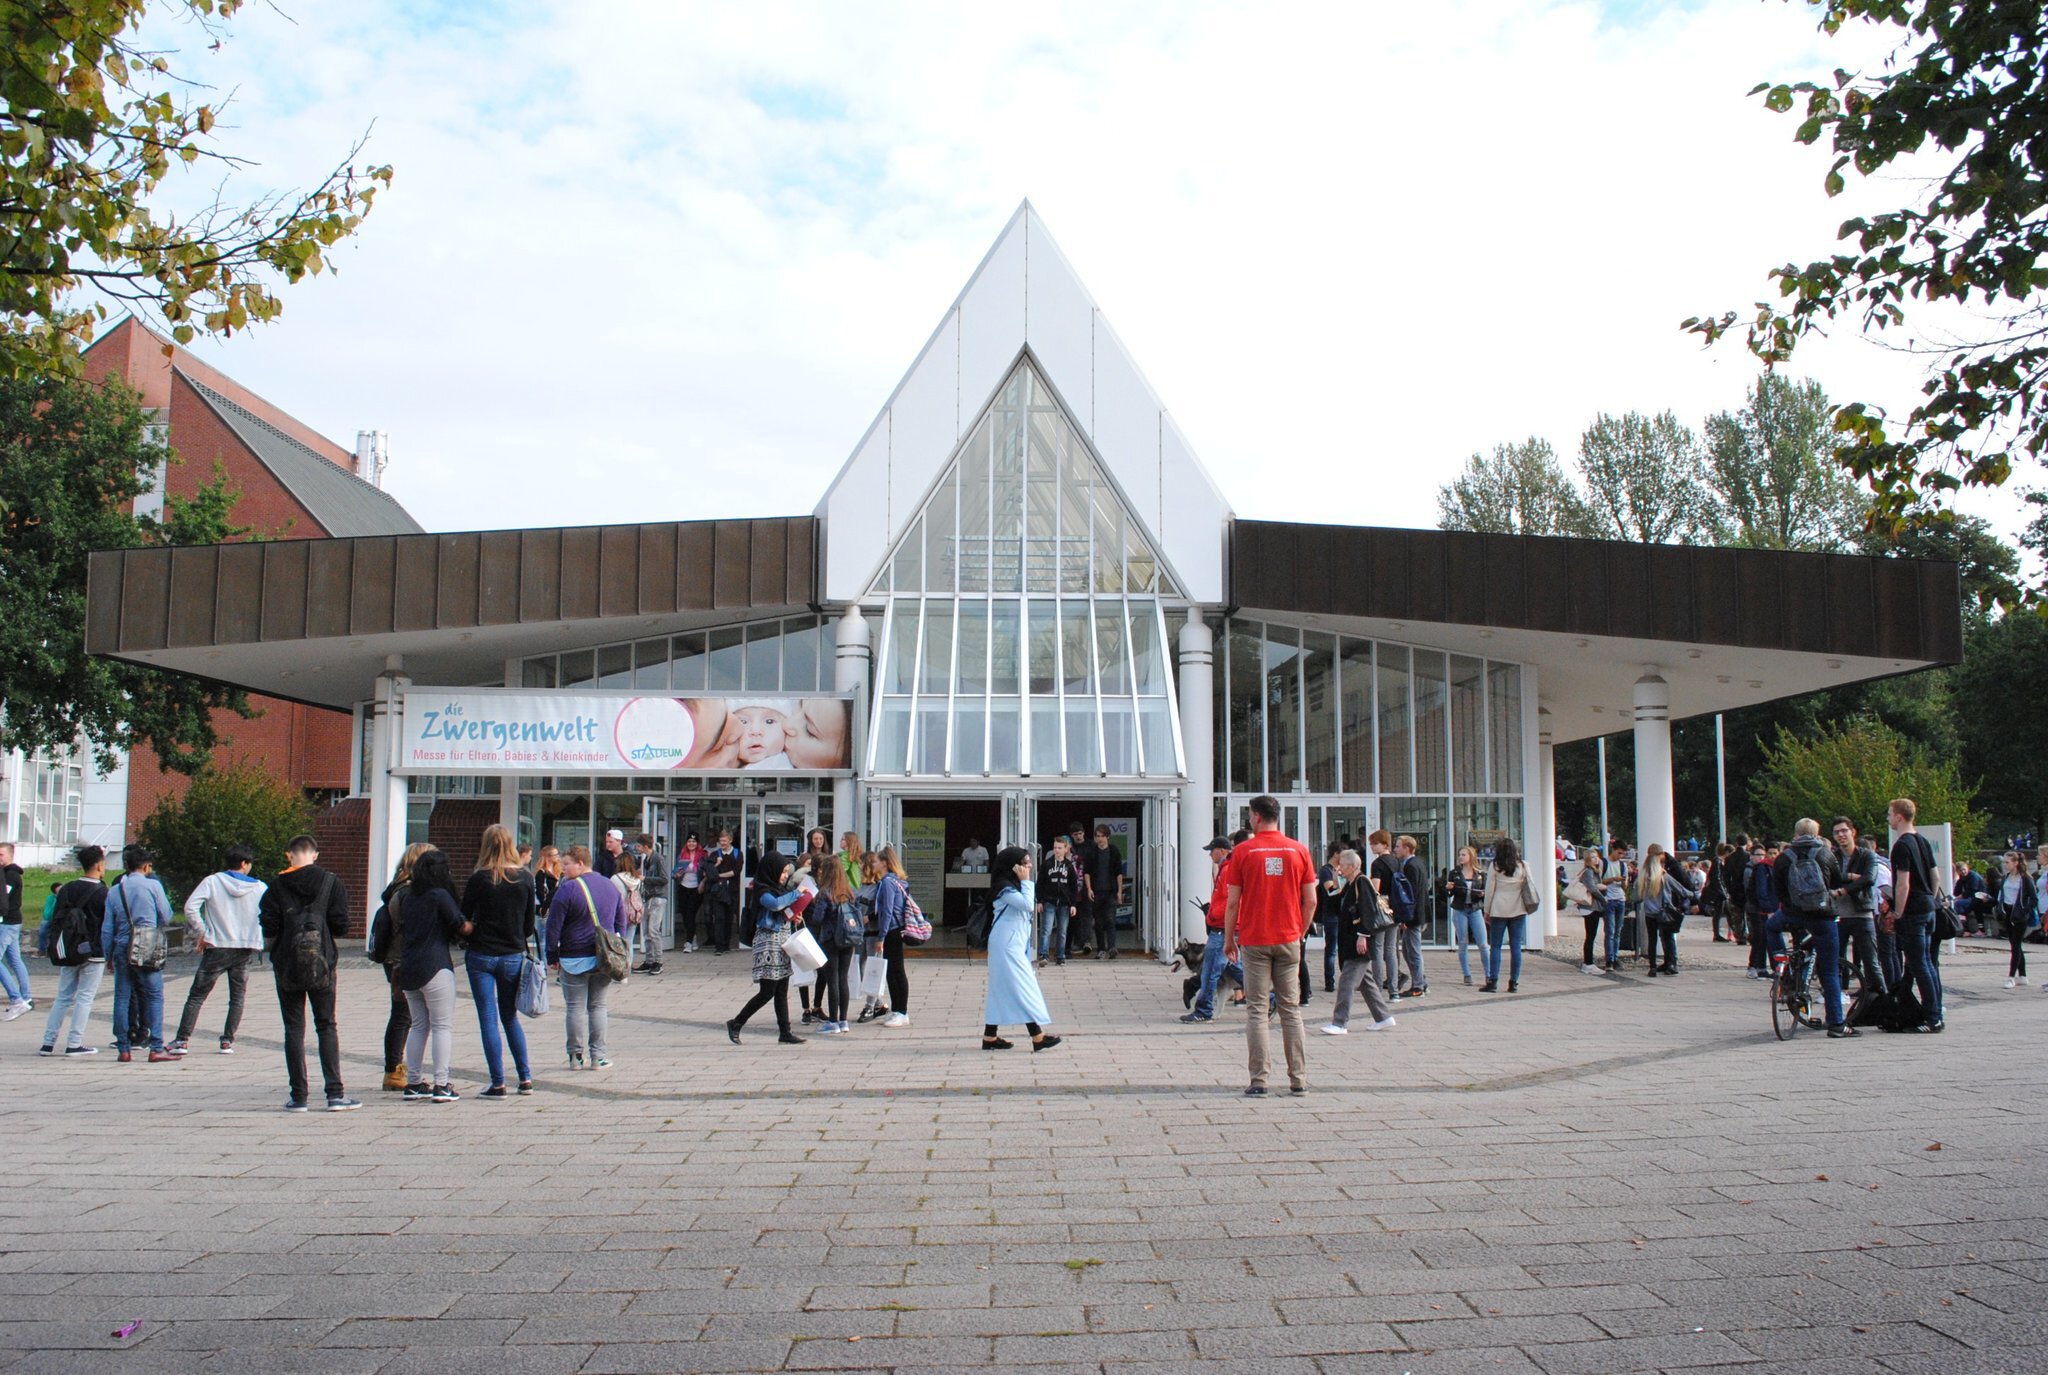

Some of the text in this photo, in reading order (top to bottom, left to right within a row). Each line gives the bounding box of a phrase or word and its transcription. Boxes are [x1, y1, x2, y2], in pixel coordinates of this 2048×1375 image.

[445, 703, 464, 716] die
[421, 711, 599, 750] Zwergenwelt
[413, 749, 609, 762] Messe für Eltern, Babies & Kleinkinder
[631, 743, 683, 760] STADEUM
